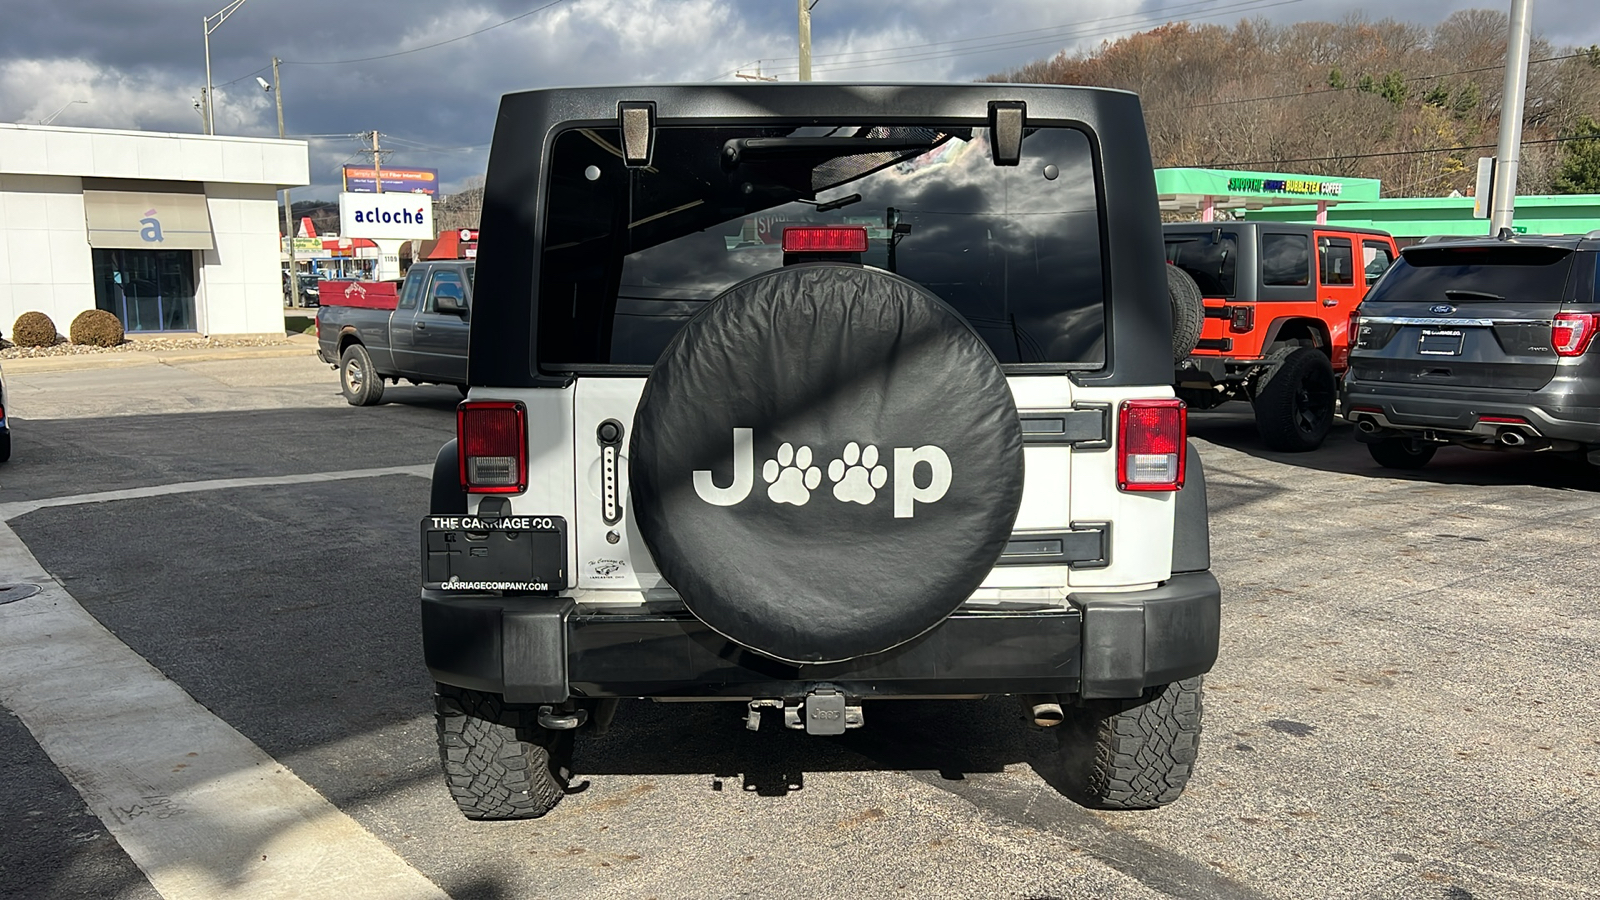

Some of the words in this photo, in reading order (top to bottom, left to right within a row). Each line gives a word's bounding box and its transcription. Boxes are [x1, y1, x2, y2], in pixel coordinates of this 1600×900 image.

[1321, 183, 1342, 194] COFFEE
[354, 206, 424, 224] acloché
[431, 517, 459, 530] THE
[532, 517, 556, 530] CO.
[441, 581, 549, 592] CARRIAGECOMPANY.COM
[811, 707, 841, 721] Jeep
